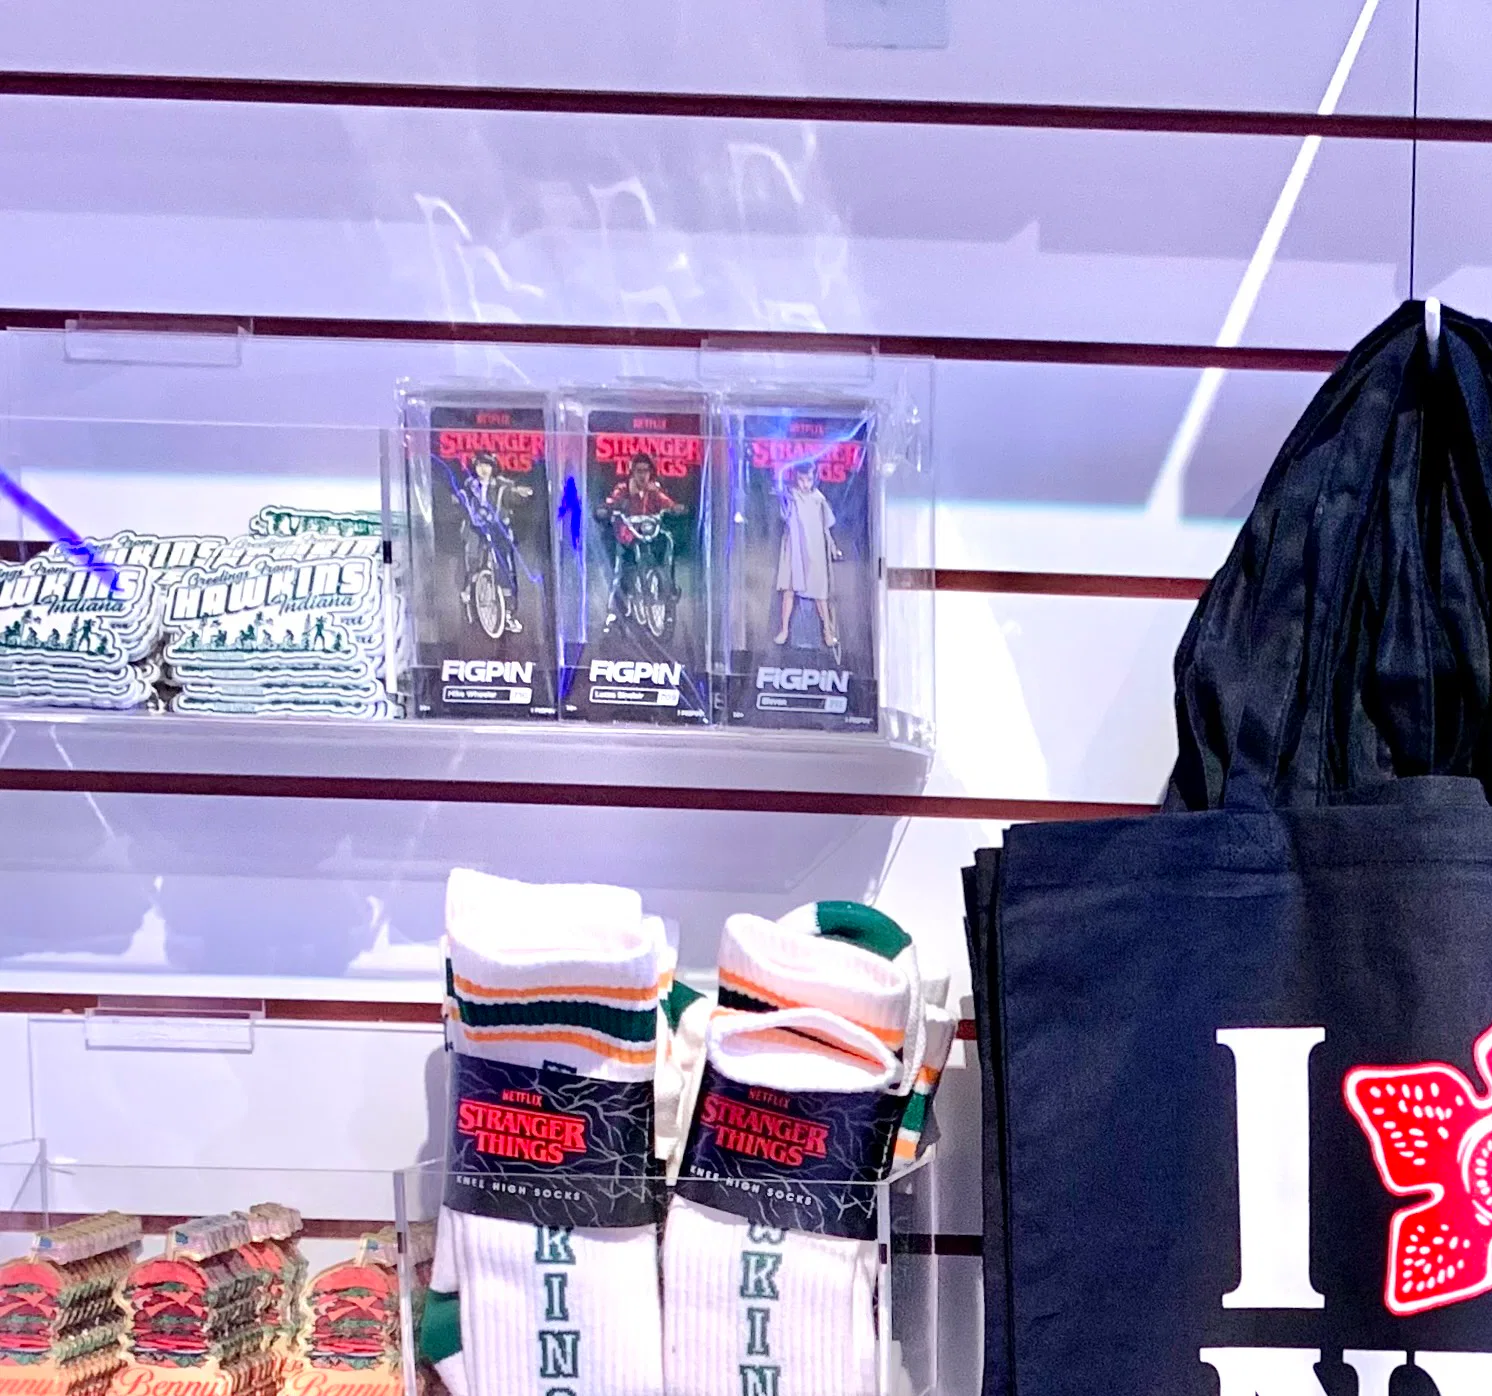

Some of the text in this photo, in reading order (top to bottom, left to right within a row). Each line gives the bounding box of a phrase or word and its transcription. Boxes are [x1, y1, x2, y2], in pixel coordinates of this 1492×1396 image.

[440, 430, 545, 459] STRANGER
[596, 434, 702, 465] STRANGER
[187, 559, 297, 587] Greetings From
[41, 594, 125, 615] Indiana
[171, 562, 365, 621] HAWKINS
[271, 592, 355, 616] Indiana
[502, 1089, 543, 1106] NETFLIX
[749, 1089, 791, 1109] NETFLIX
[458, 1101, 587, 1150] STRANGER
[702, 1093, 829, 1156] STRANGER
[475, 1130, 564, 1164] THINGS
[715, 1125, 804, 1167] THINGS
[1215, 1026, 1326, 1310] I
[492, 1182, 527, 1196] HIGH
[534, 1187, 581, 1201] SOCKS
[726, 1176, 761, 1194] HIGH
[767, 1188, 812, 1206] SOCKS
